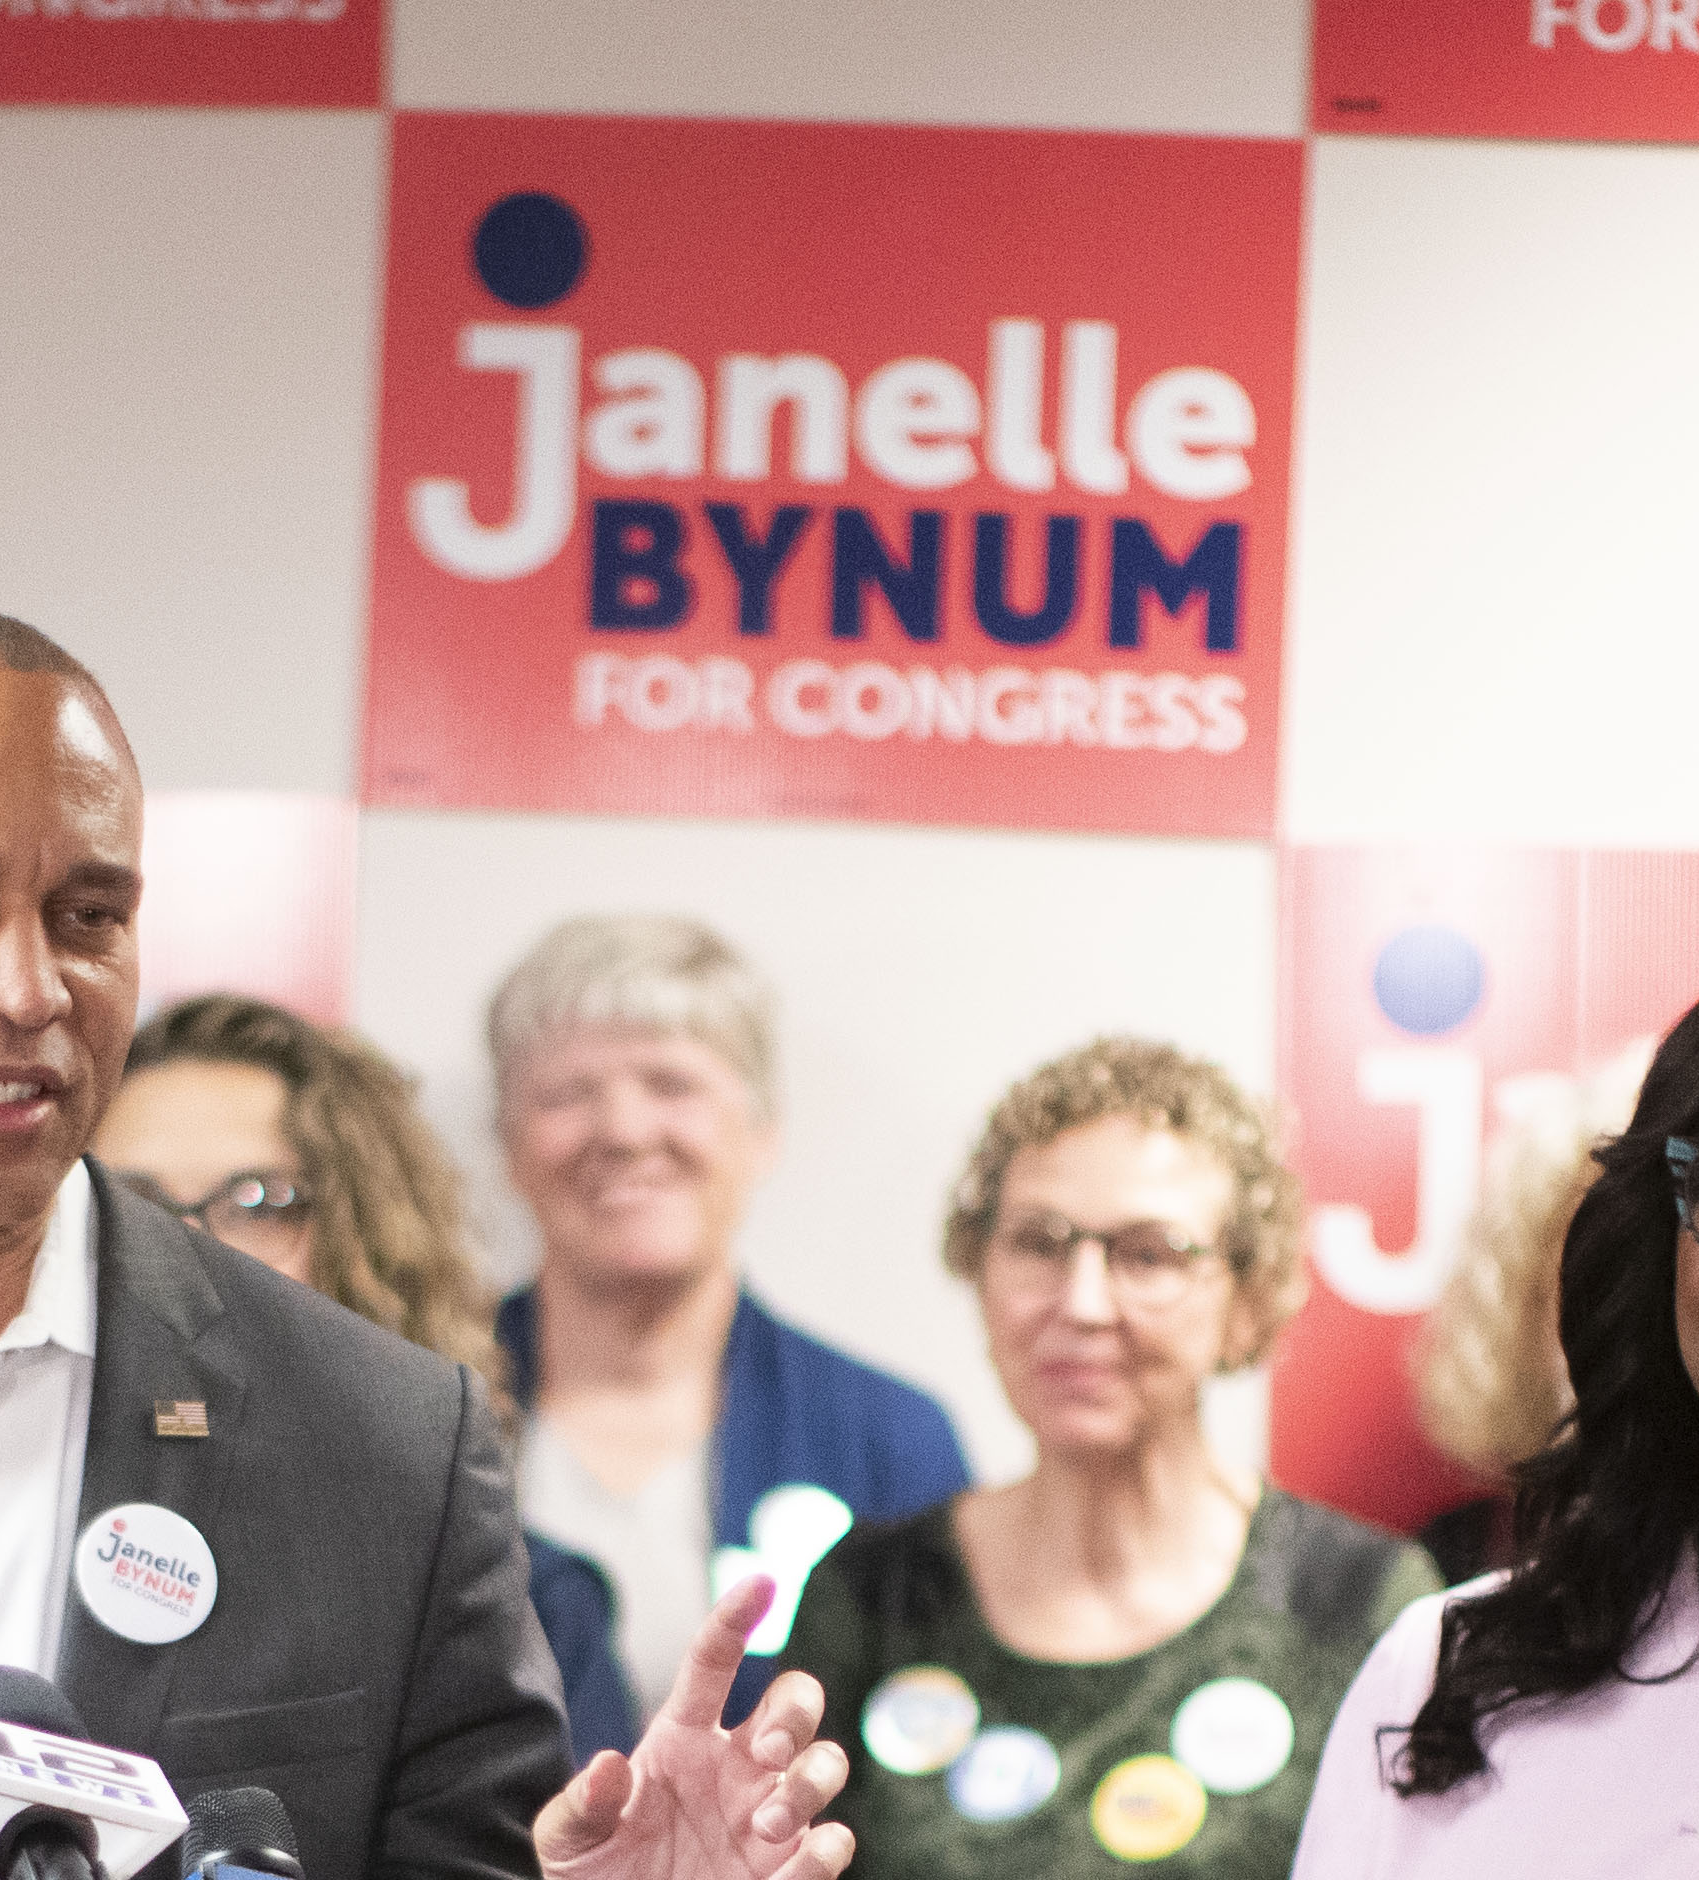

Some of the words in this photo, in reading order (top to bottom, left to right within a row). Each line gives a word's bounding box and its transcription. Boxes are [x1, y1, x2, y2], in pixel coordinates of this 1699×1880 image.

[589, 499, 1246, 653] BYNUM
[575, 653, 754, 731] FOR
[769, 658, 1248, 754] CONGRESS
[115, 1559, 195, 1606] BYNUM
